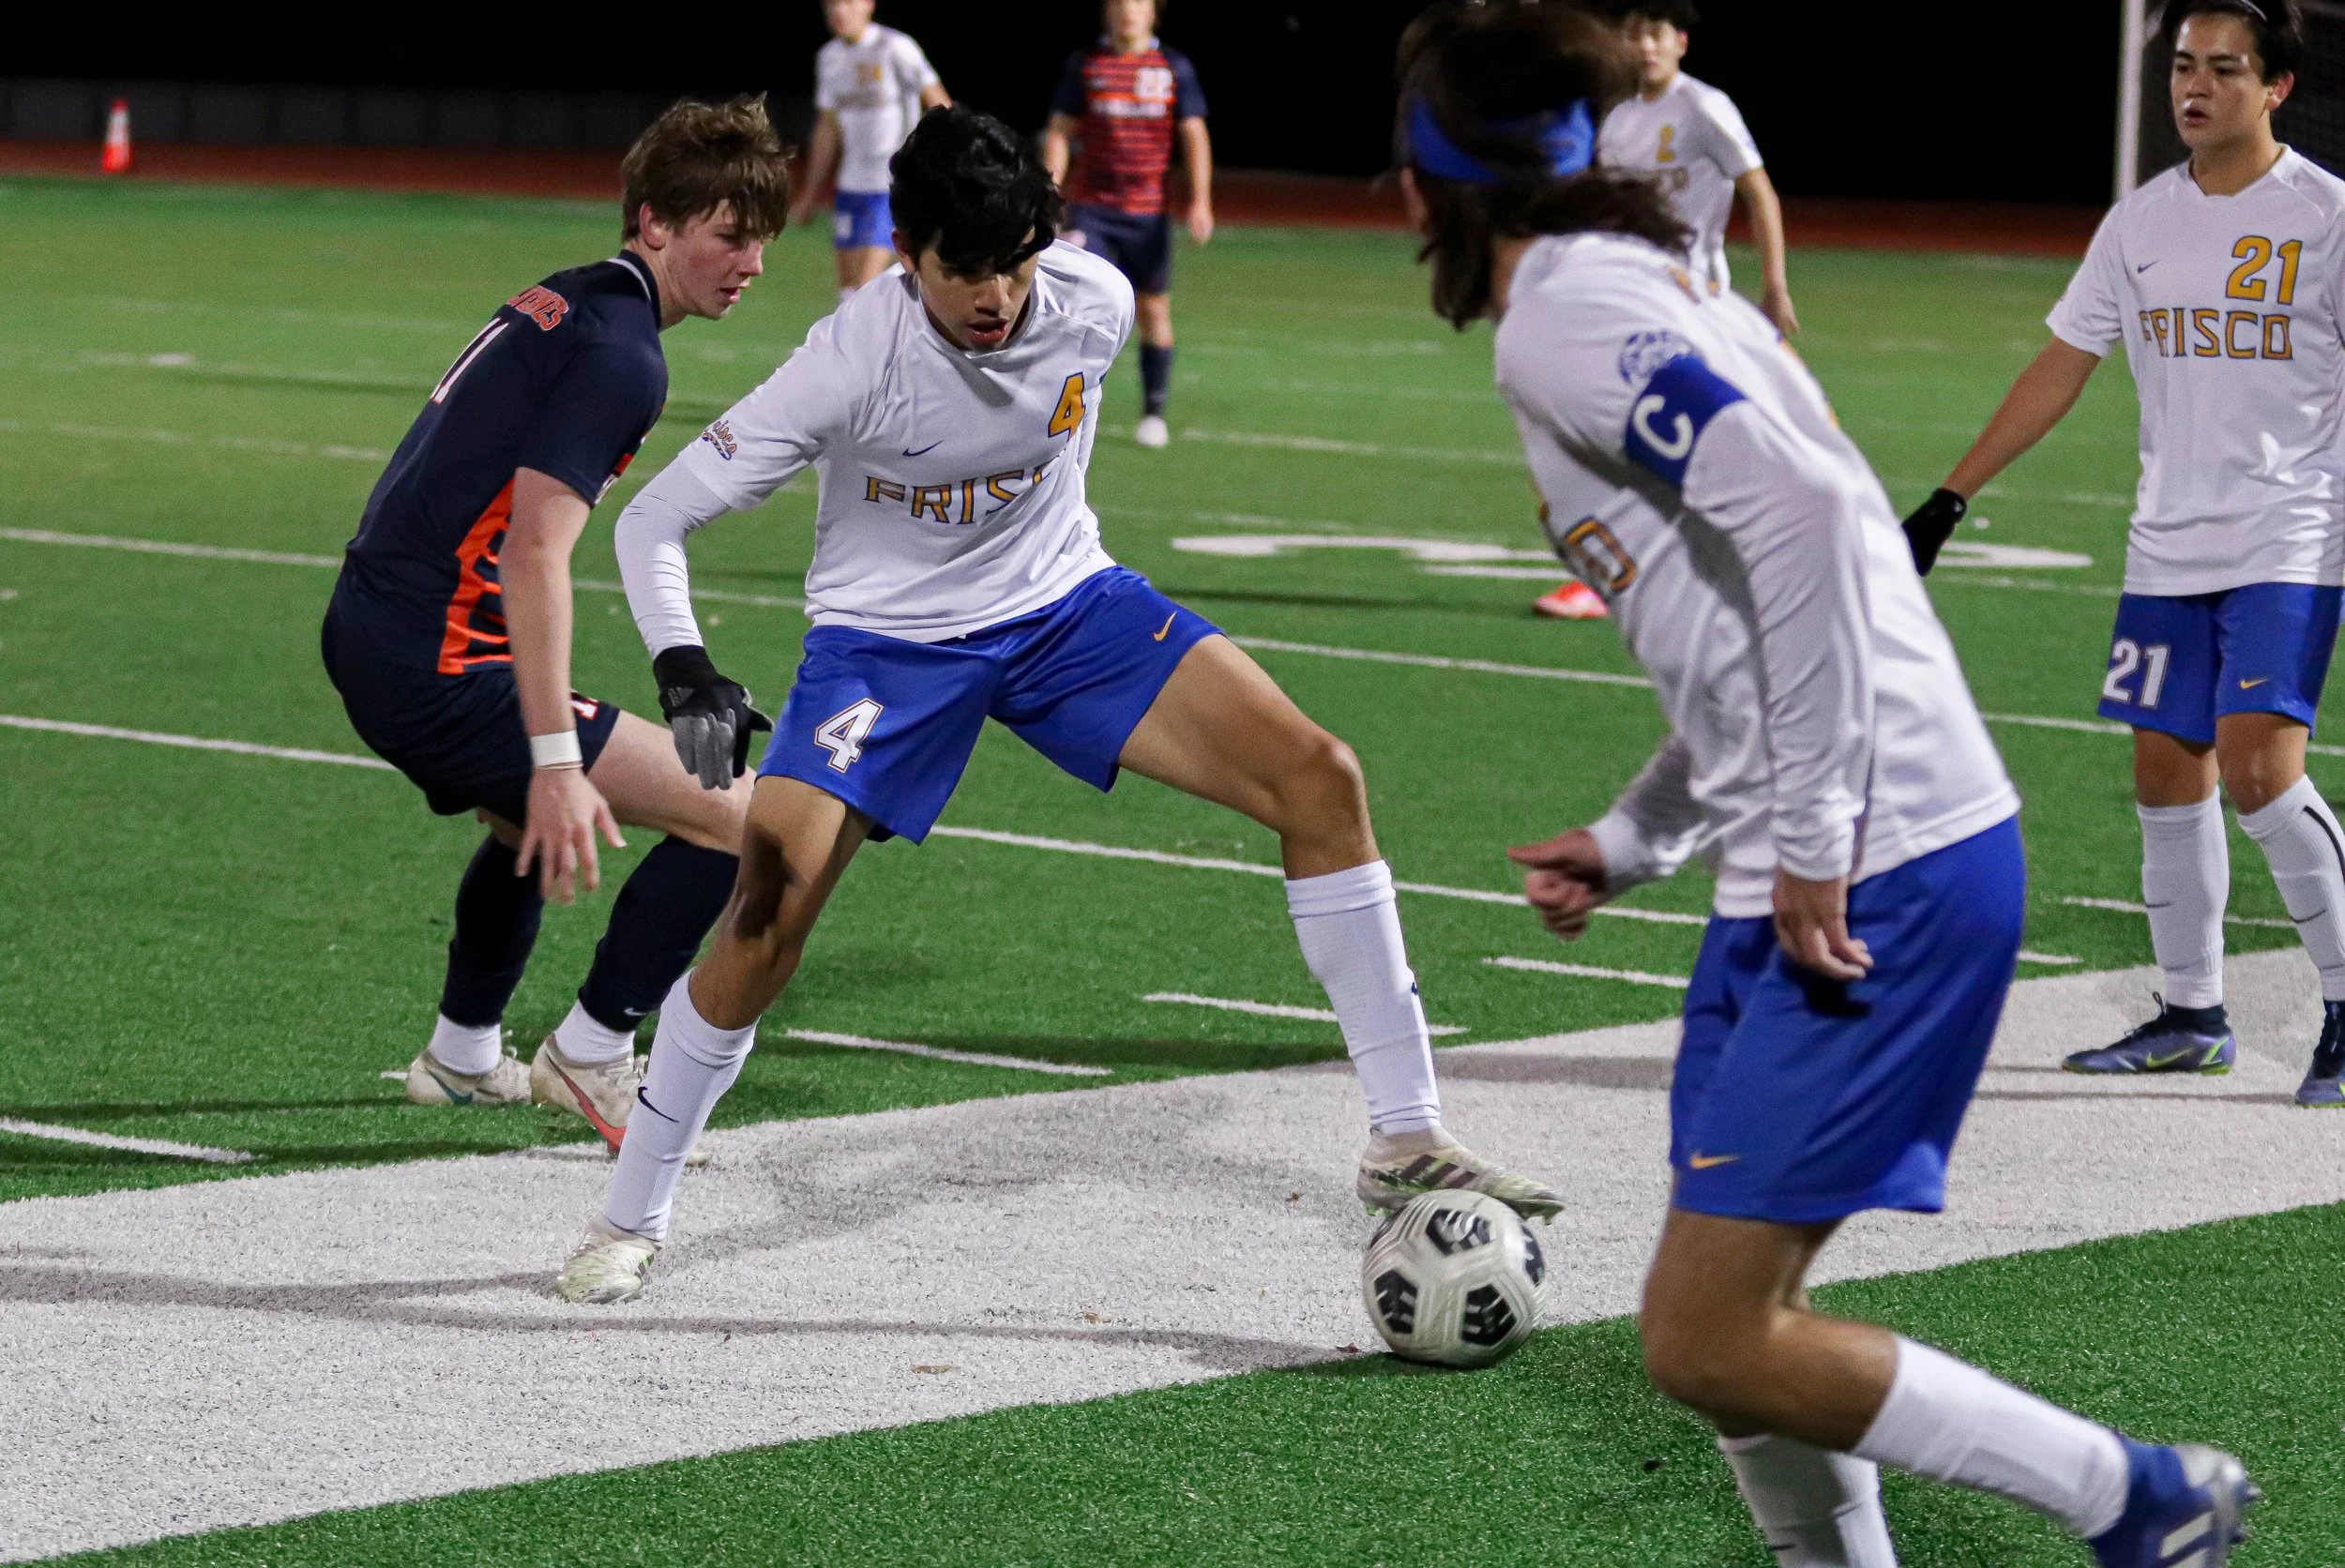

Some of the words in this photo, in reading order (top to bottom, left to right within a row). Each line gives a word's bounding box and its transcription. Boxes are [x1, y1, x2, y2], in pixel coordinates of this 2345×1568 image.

[2225, 234, 2303, 305] 21
[2139, 307, 2293, 361] FRISCO
[1048, 371, 1086, 443] 4
[1631, 394, 1693, 460] C
[863, 463, 1051, 525] FRIS
[2102, 639, 2171, 710] 21
[814, 697, 885, 773] 4
